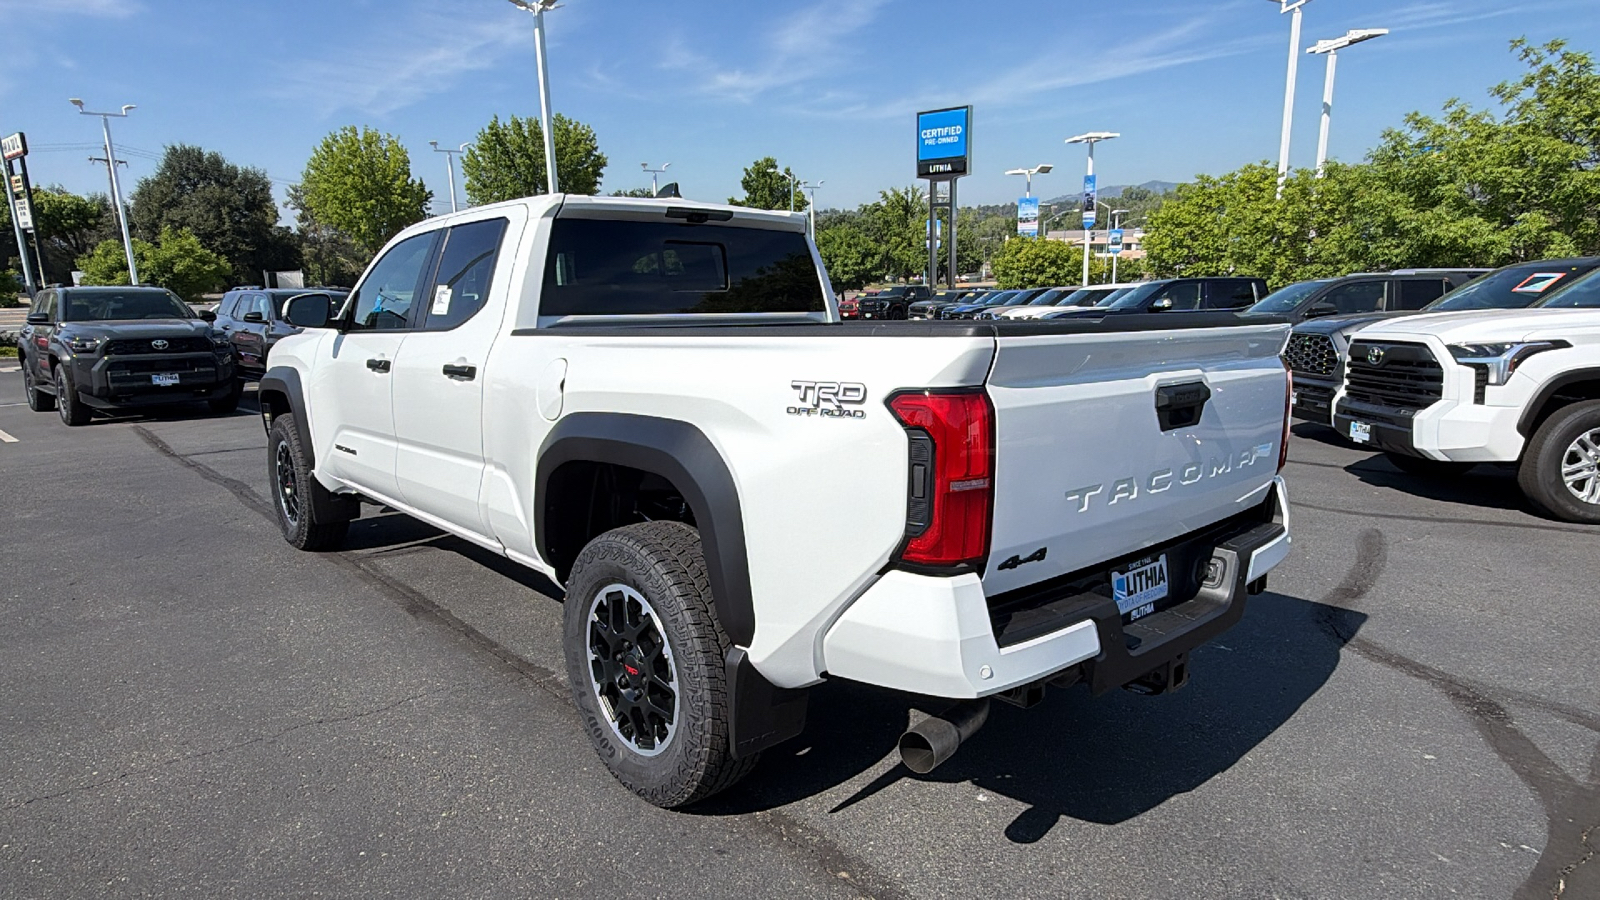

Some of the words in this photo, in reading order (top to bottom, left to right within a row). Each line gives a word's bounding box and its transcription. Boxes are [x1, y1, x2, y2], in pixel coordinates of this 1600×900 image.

[921, 125, 962, 139] CERTIFIED
[924, 136, 959, 146] PRE-OWNED
[929, 163, 952, 173] LITHIA
[791, 380, 867, 408] TRD
[786, 406, 818, 417] OFF
[820, 409, 867, 419] ROAD
[1065, 449, 1262, 513] TACOMA
[1126, 564, 1166, 597] LITHIA
